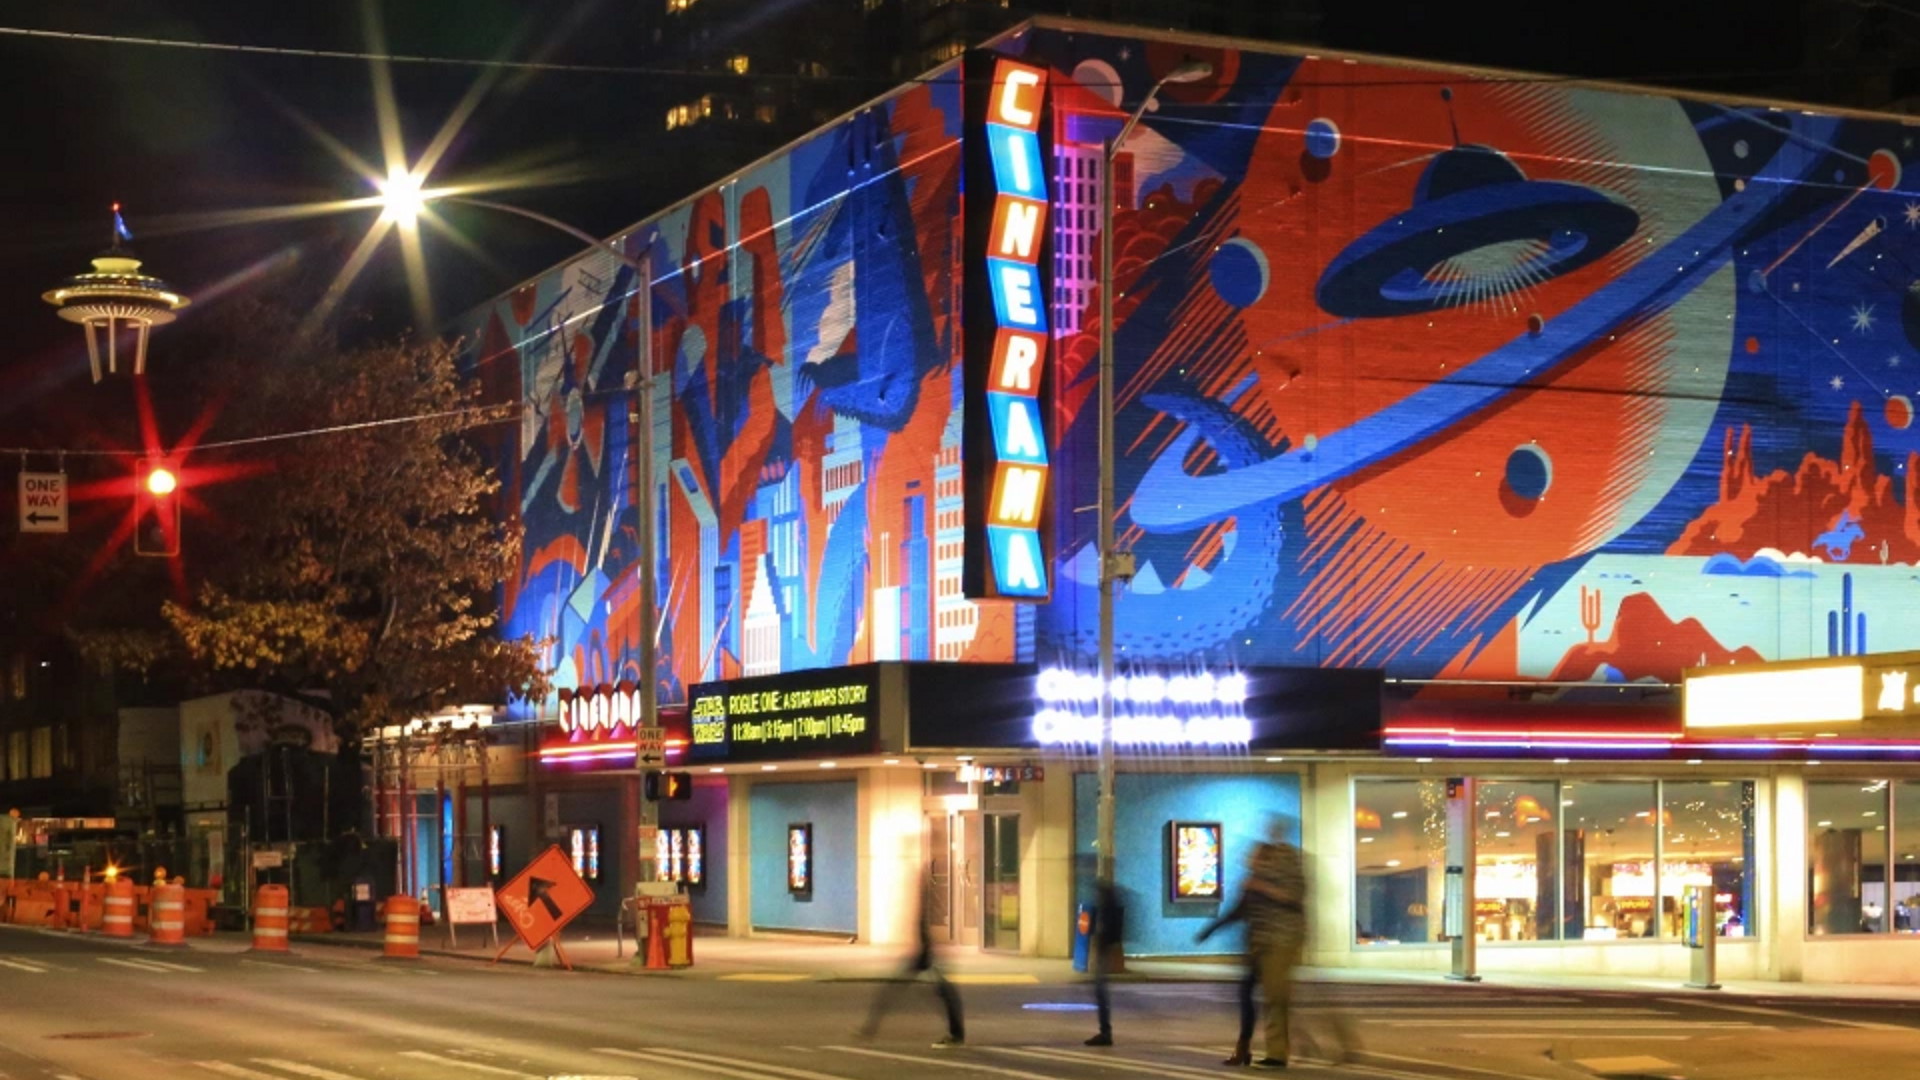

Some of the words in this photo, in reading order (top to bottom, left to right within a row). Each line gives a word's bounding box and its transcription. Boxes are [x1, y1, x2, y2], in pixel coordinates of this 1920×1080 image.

[999, 69, 1040, 589] CINERAMA
[25, 479, 60, 492] ONE
[26, 494, 60, 507] WAY
[729, 693, 759, 714] ROGUE
[783, 693, 790, 709] A
[790, 690, 812, 708] STAR
[812, 688, 837, 706] WARS
[838, 685, 868, 704] STORY
[640, 729, 662, 740] ONE
